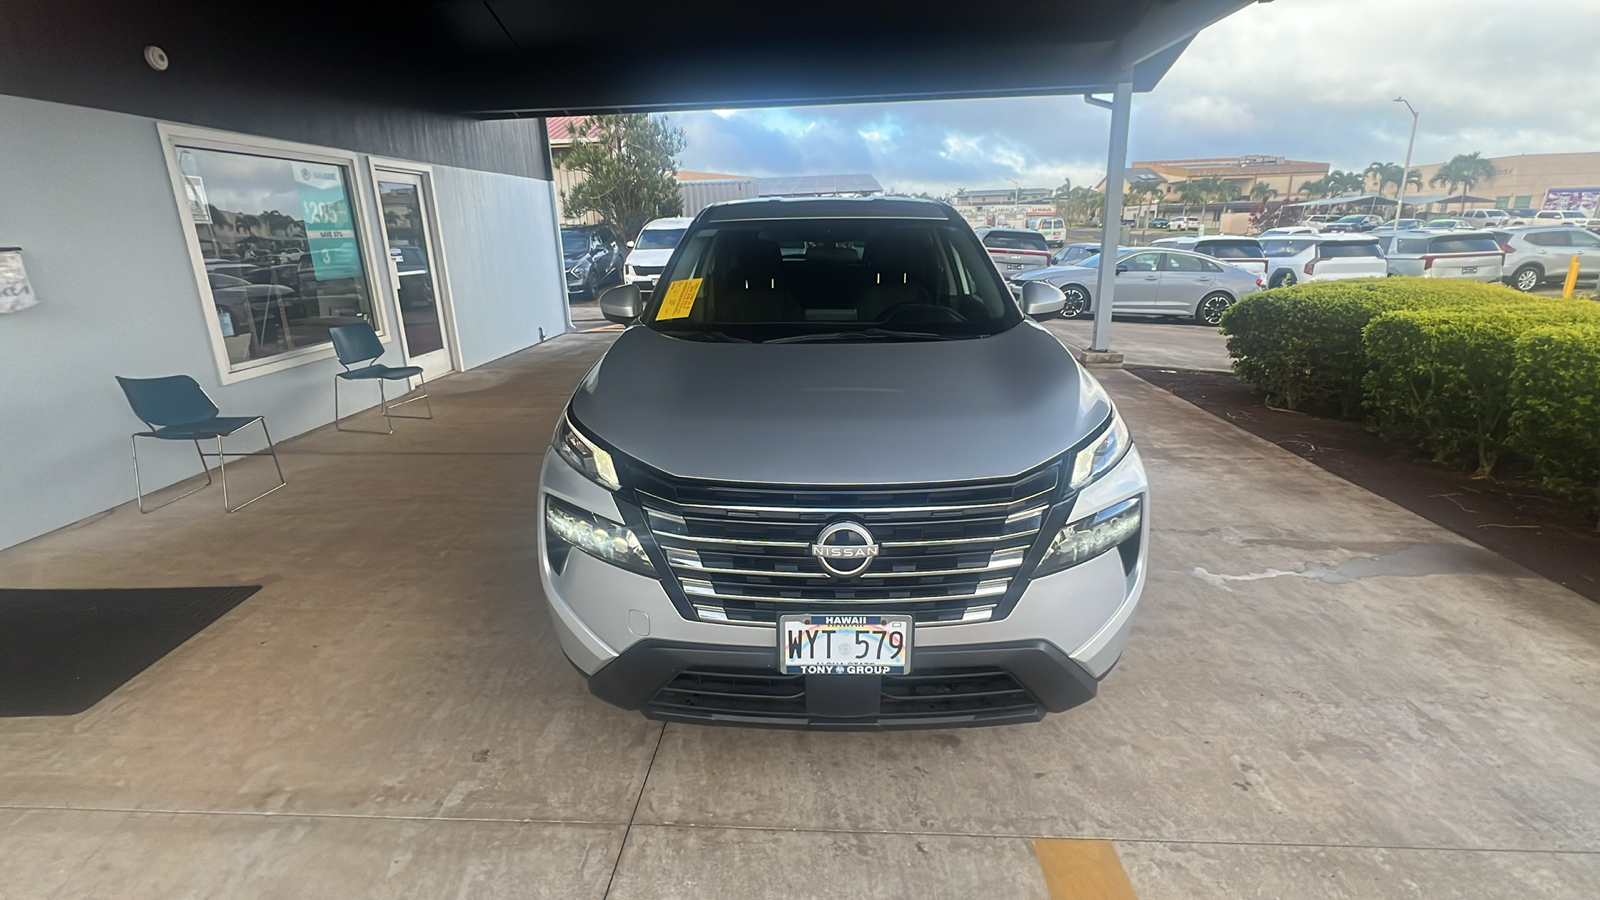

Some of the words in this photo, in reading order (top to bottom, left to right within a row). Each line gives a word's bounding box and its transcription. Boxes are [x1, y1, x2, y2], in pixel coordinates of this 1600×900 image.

[813, 546, 877, 557] NISSAN
[825, 616, 867, 624] HAWAII
[788, 630, 836, 659] WYT
[855, 630, 904, 659] 579
[801, 665, 833, 674] TONY
[846, 665, 891, 674] GROUP
